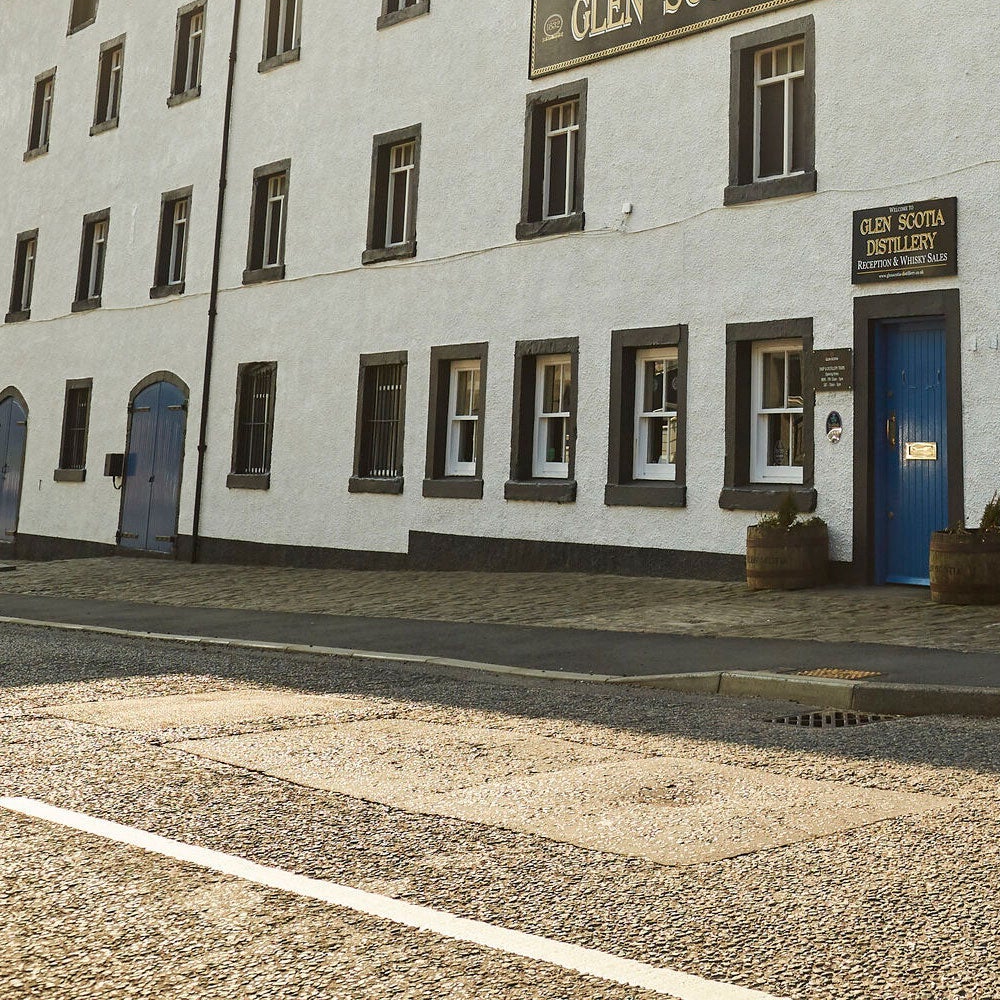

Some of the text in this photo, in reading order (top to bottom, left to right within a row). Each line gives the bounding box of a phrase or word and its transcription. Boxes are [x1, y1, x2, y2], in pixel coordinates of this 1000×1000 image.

[860, 209, 945, 236] GLEN SCOTIA
[866, 231, 938, 257] DISTILLERY
[857, 252, 948, 270] RECEPTION & WHISKY SALES
